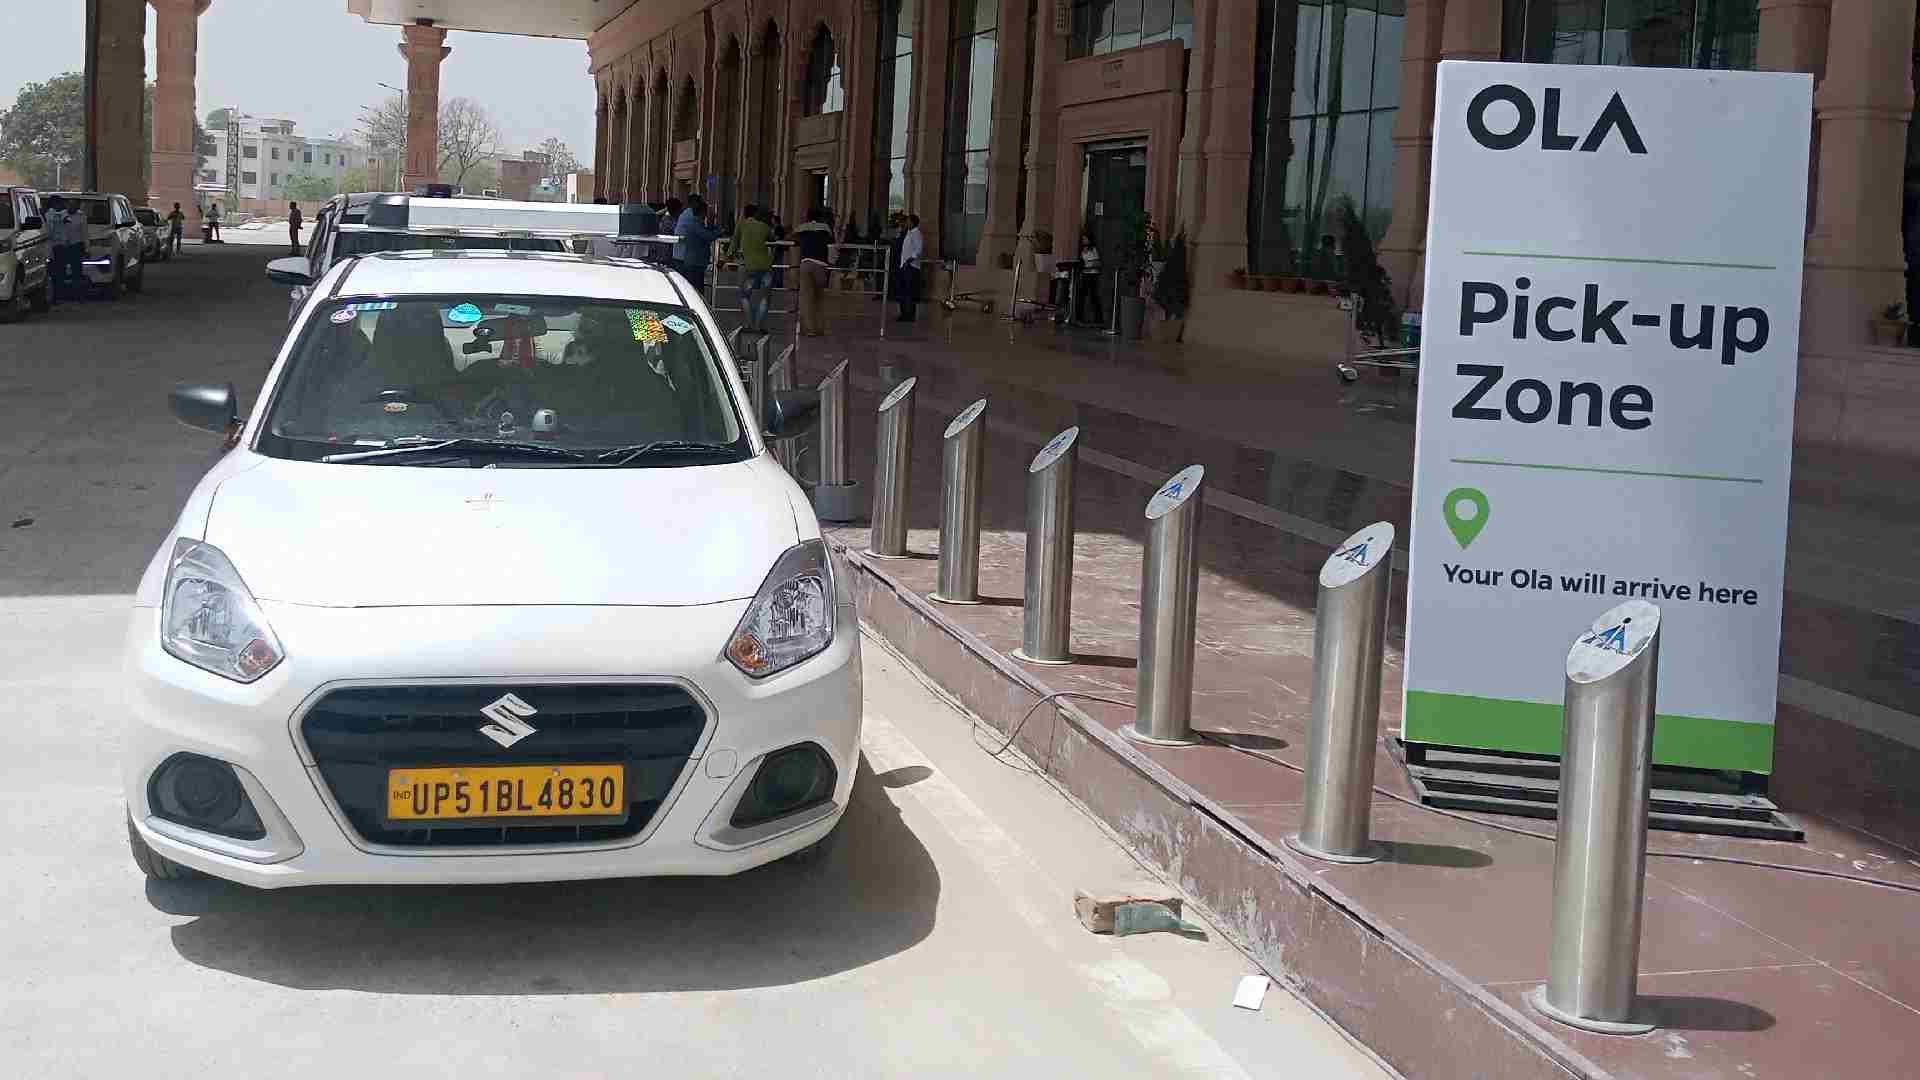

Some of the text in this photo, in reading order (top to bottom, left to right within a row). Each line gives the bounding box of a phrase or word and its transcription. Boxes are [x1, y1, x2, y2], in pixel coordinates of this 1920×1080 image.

[1467, 84, 1648, 154] OLA
[1458, 277, 1770, 365] Pick-up
[1451, 363, 1654, 430] Zone
[1443, 563, 1758, 606] Your Ola will arrive here
[412, 777, 616, 815] UP51BL4830
